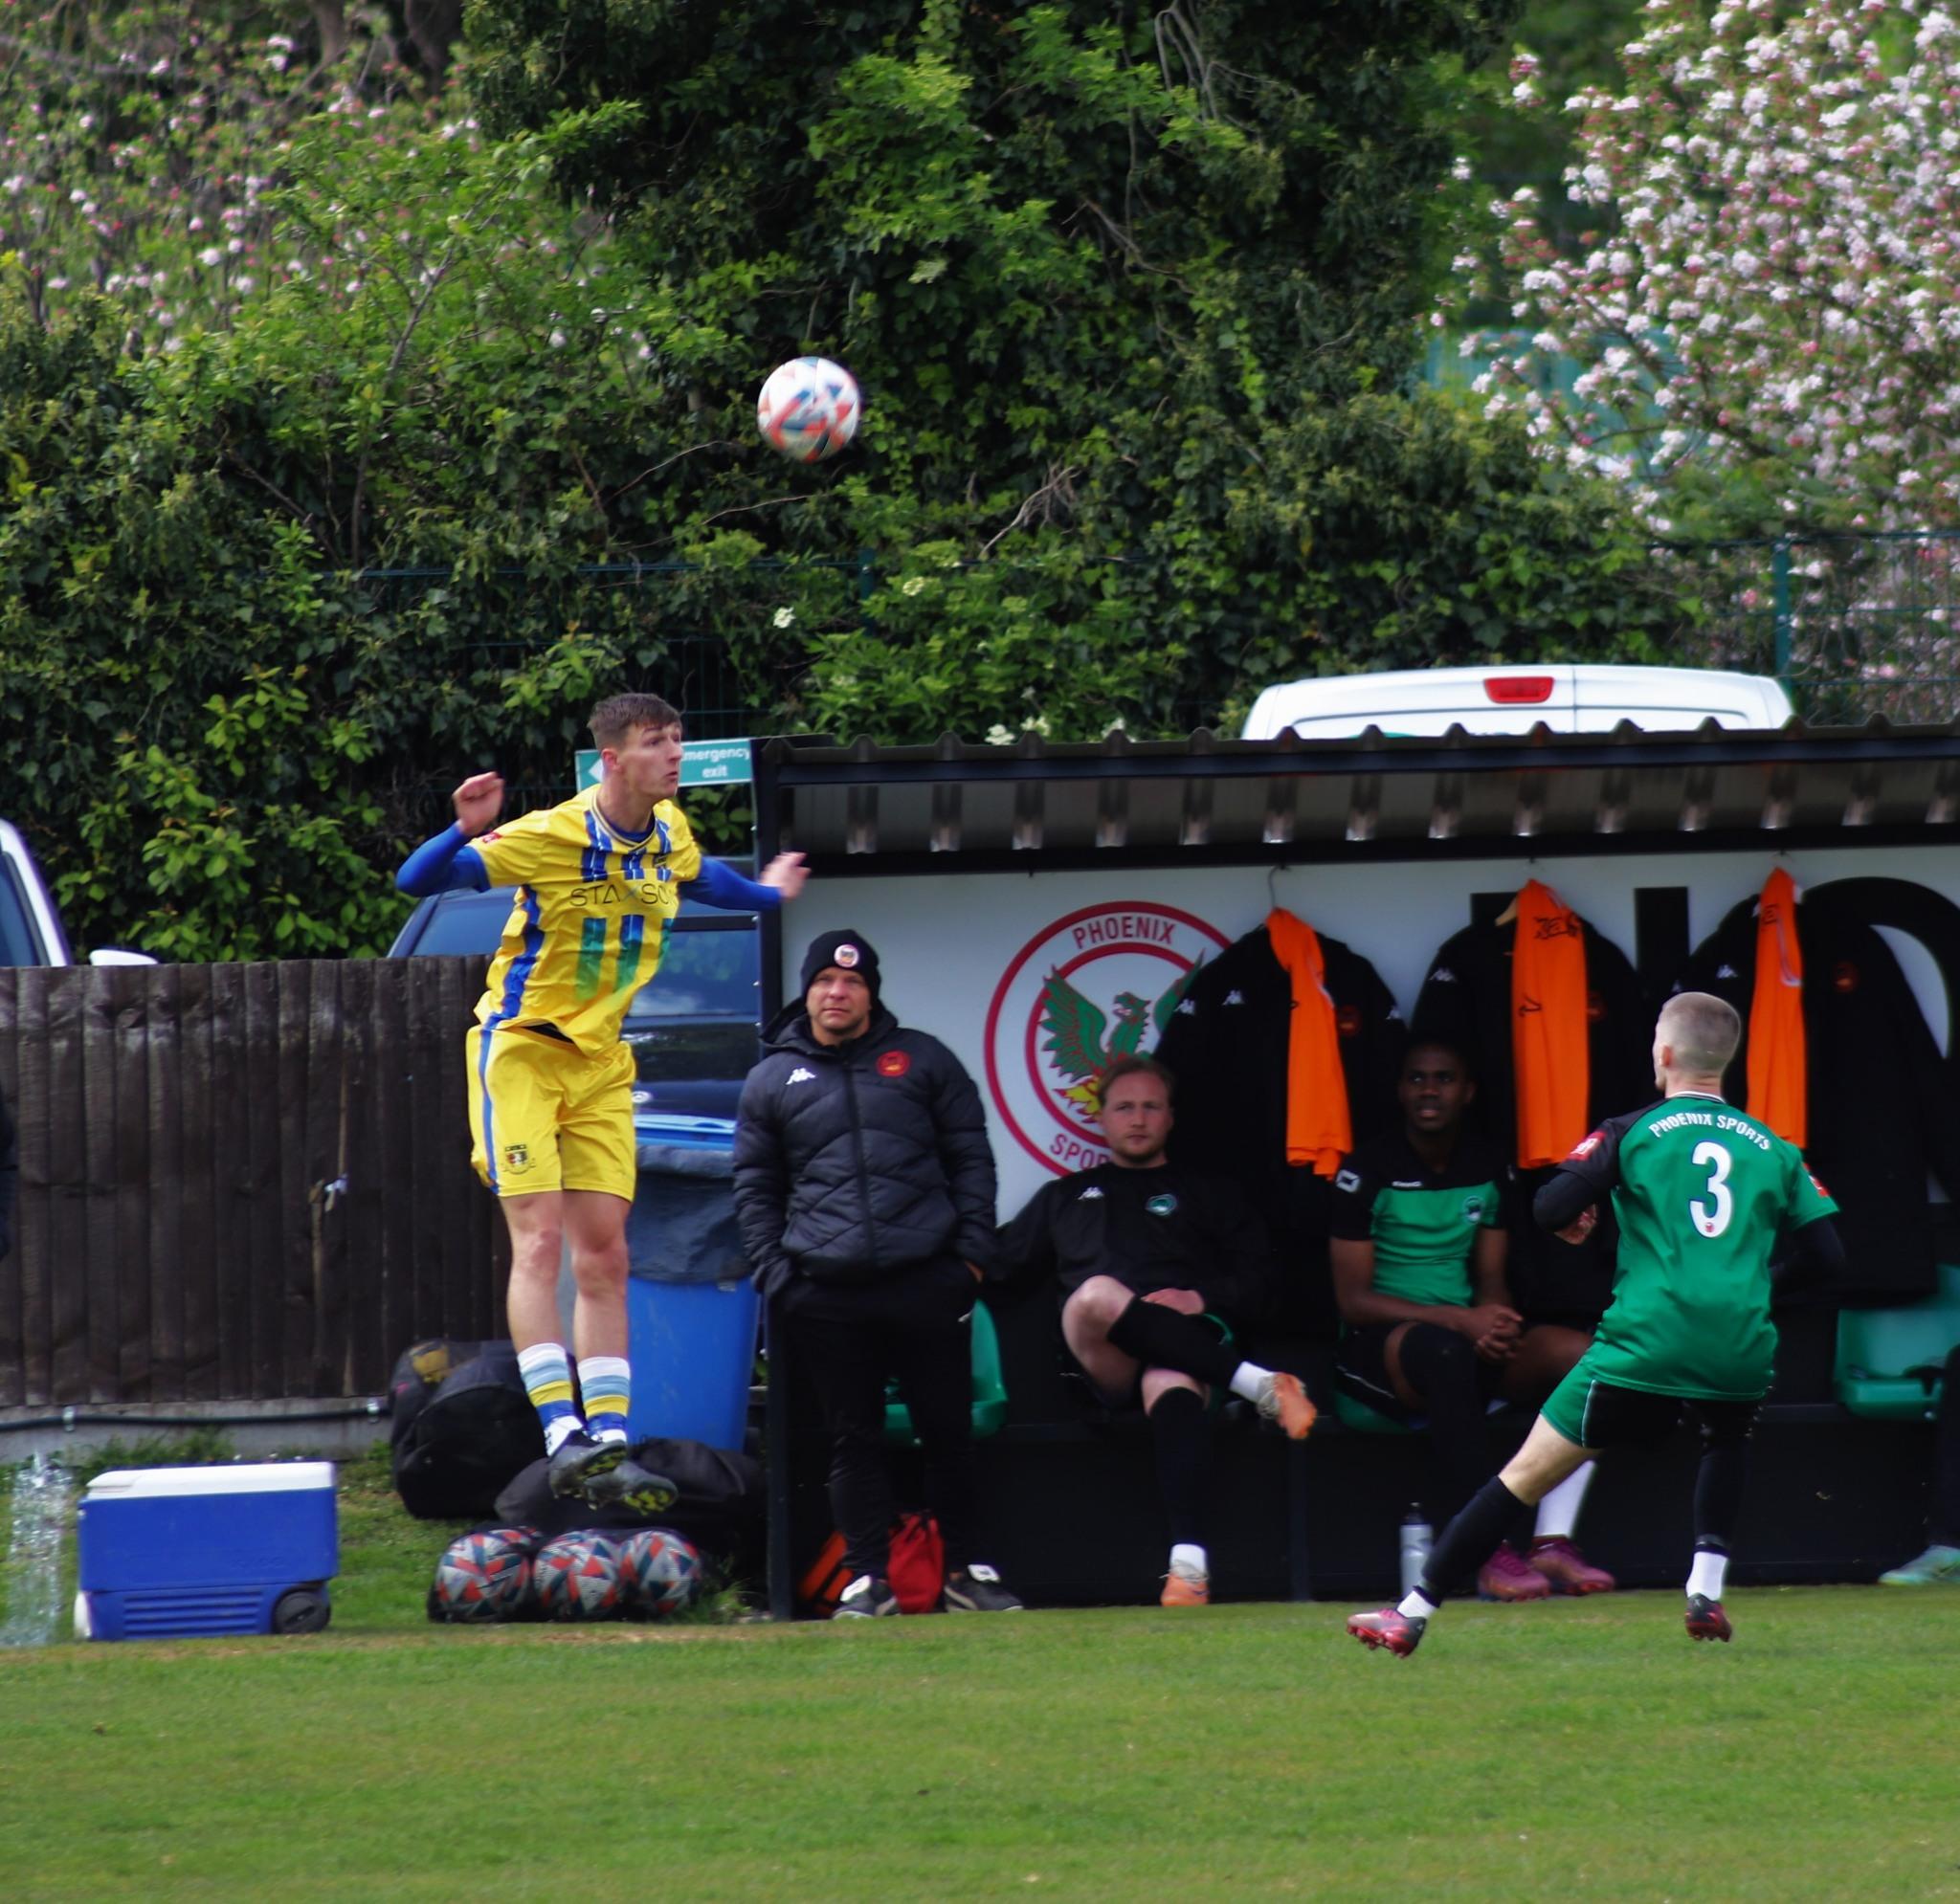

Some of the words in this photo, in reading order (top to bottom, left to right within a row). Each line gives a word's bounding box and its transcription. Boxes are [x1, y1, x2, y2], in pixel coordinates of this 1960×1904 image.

[702, 764, 728, 779] exit
[1072, 916, 1175, 949] PHOENIX
[1649, 1113, 1712, 1138] PHOENIX
[1717, 1115, 1771, 1150] SPORTS
[1689, 1140, 1733, 1238] 3
